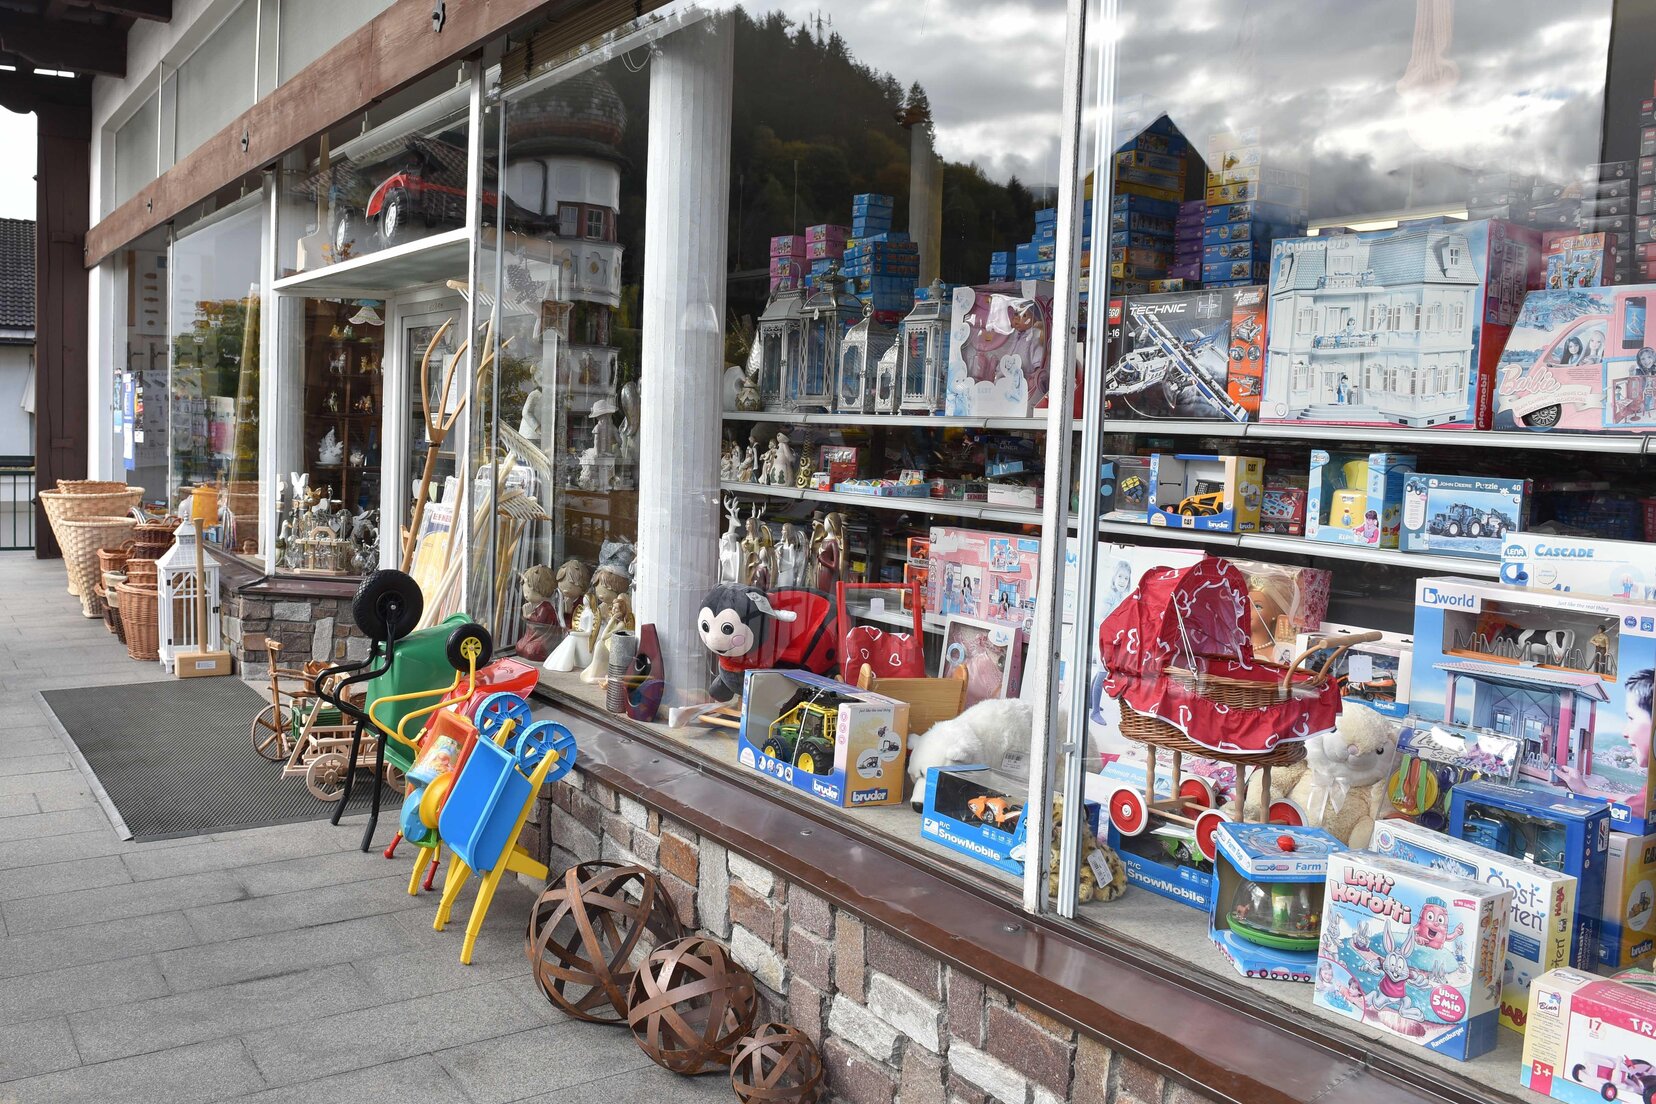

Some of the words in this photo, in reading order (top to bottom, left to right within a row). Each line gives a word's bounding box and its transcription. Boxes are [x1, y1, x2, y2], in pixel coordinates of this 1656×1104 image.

[1108, 308, 1120, 318] EGO
[1129, 303, 1187, 316] TECHNIC
[1108, 328, 1120, 338] -16
[1499, 363, 1561, 395] Barbie
[1479, 373, 1488, 428] playmobil
[1475, 481, 1498, 490] Puzzle
[1208, 520, 1229, 530] bruder
[813, 780, 839, 799] bruder
[851, 789, 888, 802] bruder
[938, 828, 1001, 861] SnowMobile
[1127, 859, 1142, 870] R/C
[1295, 862, 1322, 871] Farm
[1127, 867, 1206, 905] SnowMobile
[1343, 866, 1396, 896] Lotti
[1330, 879, 1412, 925] Karotti
[1554, 886, 1565, 917] HABA
[1631, 940, 1654, 958] bruder
[1432, 994, 1441, 1006] 5
[1441, 998, 1463, 1014] Mio.
[1538, 1001, 1558, 1011] Bino
[1588, 1018, 1603, 1031] 17
[1629, 1017, 1656, 1038] TR
[1430, 1026, 1465, 1049] Ravensburger
[1533, 1063, 1552, 1077] 3+
